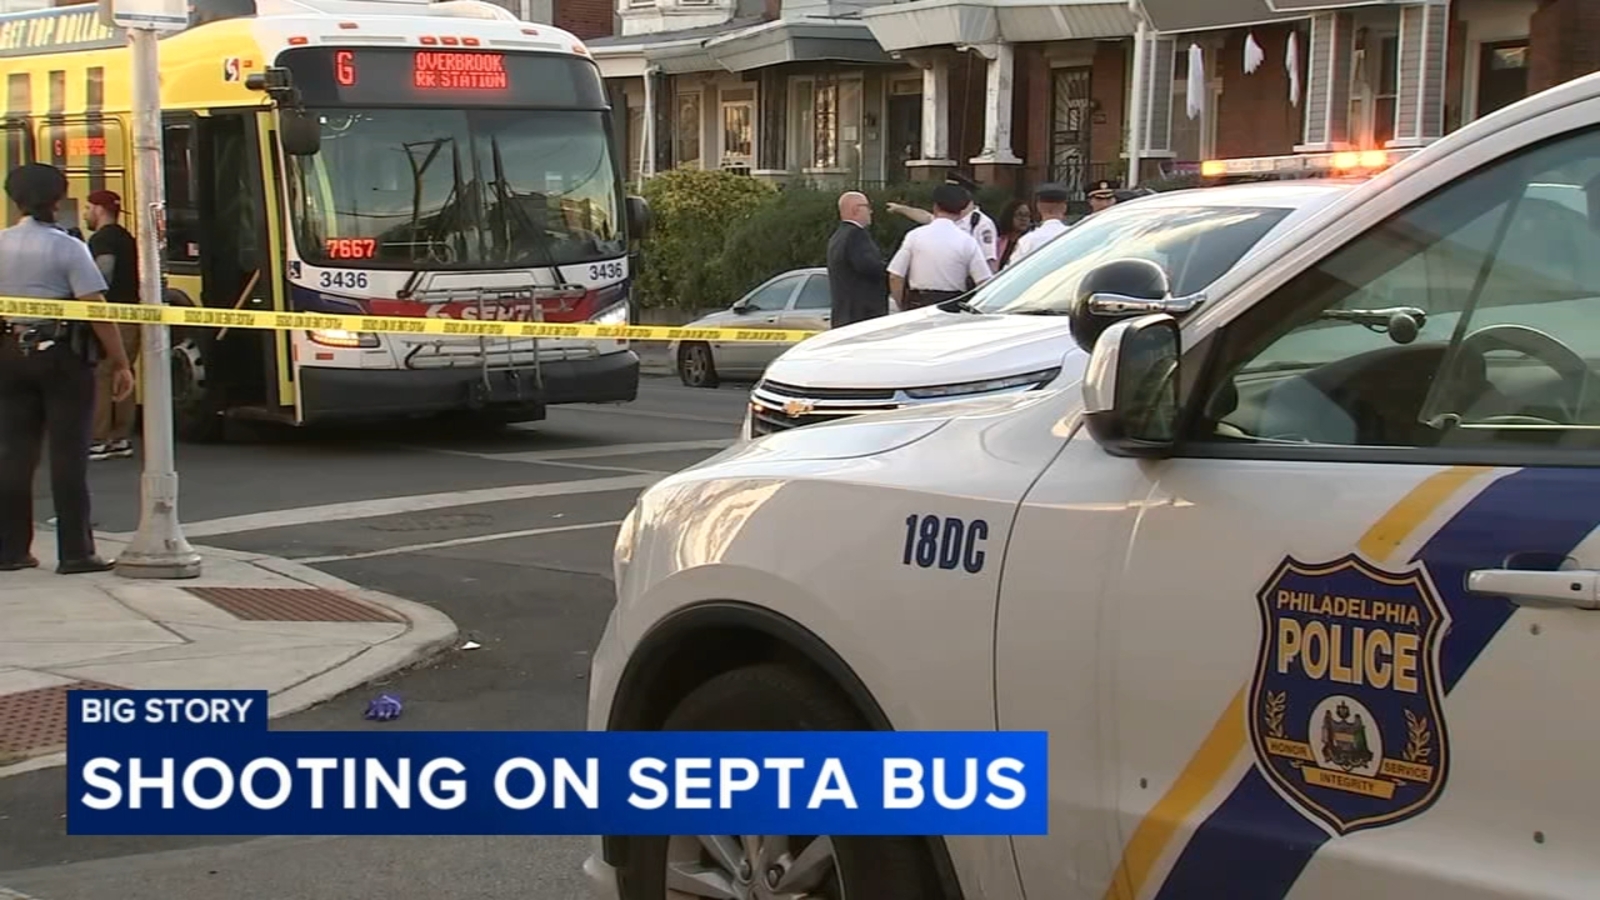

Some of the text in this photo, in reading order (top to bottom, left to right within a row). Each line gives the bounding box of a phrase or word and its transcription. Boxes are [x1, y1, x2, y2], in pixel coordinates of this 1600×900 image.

[338, 51, 353, 84] G
[416, 52, 502, 71] OVERBROOK
[441, 71, 505, 87] STATION
[327, 239, 375, 258] 7667
[320, 271, 367, 288] 3436
[590, 262, 622, 280] 3436
[903, 514, 988, 574] 18DC
[1277, 590, 1420, 626] PHILADELPHIA
[1277, 617, 1417, 693] POLICE
[1269, 742, 1307, 757] HONOR
[1384, 761, 1429, 780] SERVICE
[1319, 771, 1375, 792] INTEGRITY
